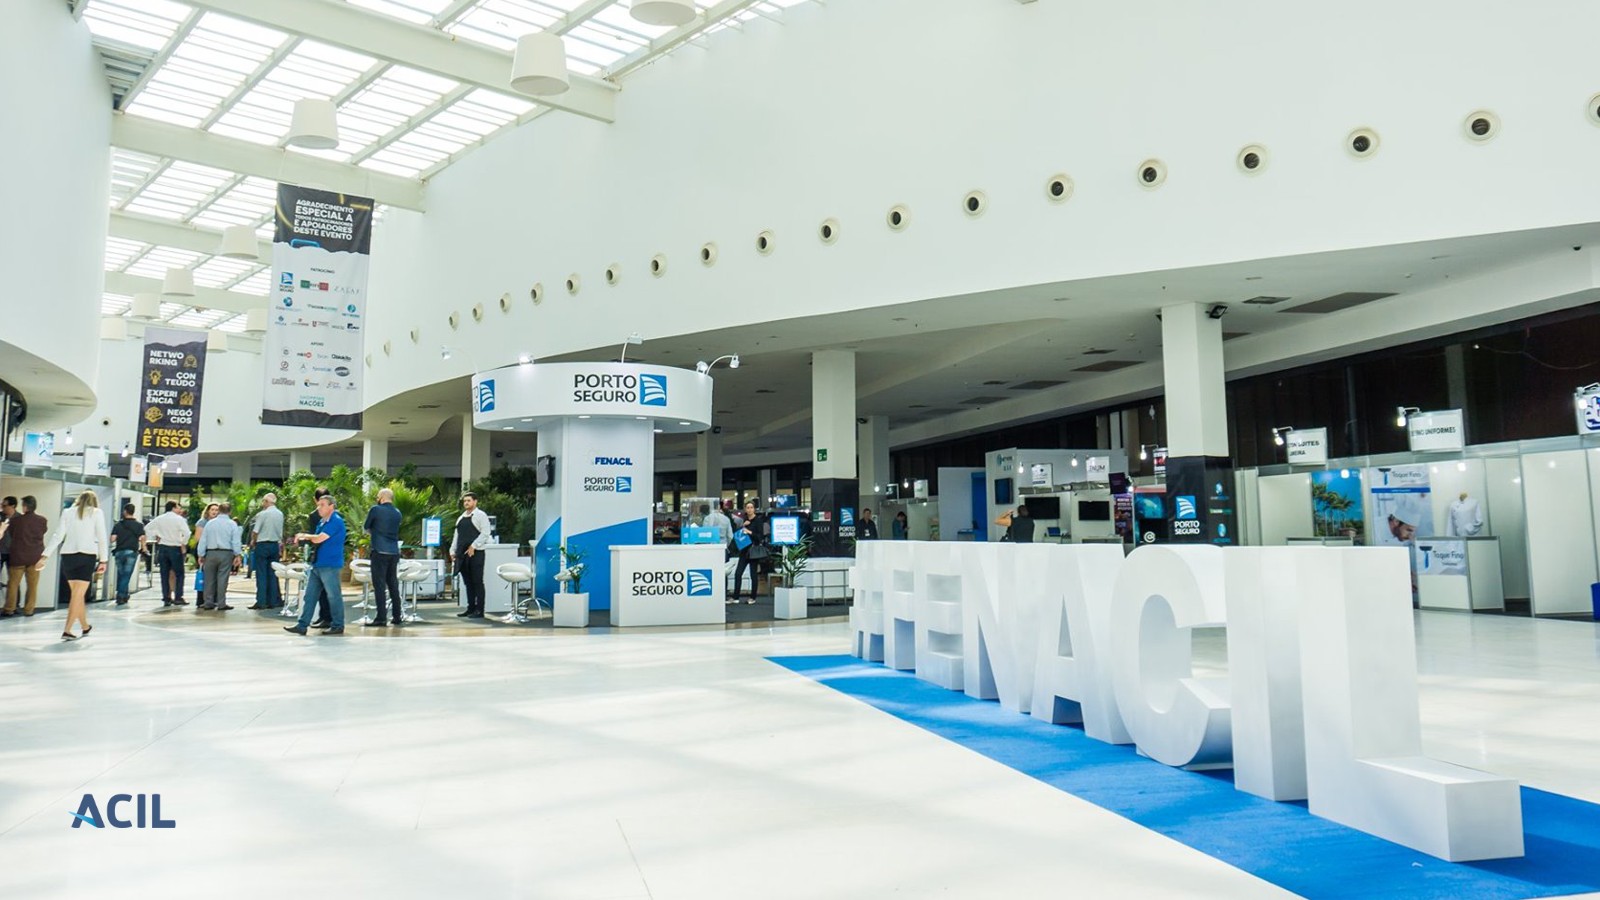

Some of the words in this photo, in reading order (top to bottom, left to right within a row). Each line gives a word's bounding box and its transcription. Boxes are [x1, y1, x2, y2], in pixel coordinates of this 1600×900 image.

[296, 199, 354, 214] AGRADECIMENTO
[295, 205, 343, 220] ESPECIAL
[345, 213, 353, 222] A
[301, 220, 353, 234] APOIADORES
[294, 226, 320, 236] DESTE
[320, 230, 353, 241] EVENTO
[150, 349, 184, 360] NETWO
[149, 357, 178, 366] RKING
[574, 374, 637, 389] PORTO
[146, 389, 178, 398] EXPERI
[573, 390, 637, 403] SEGURO
[167, 408, 193, 417] NEGÓ
[170, 416, 193, 424] CIOS
[143, 427, 151, 435] A
[153, 428, 192, 438] FENACIL
[155, 435, 192, 448] ISSO
[594, 456, 633, 466] FENACIL
[584, 477, 615, 485] PORTO
[1174, 520, 1200, 529] PORTO
[1174, 527, 1200, 536] SEGURO
[1433, 550, 1450, 560] Toque
[1450, 550, 1464, 560] Fino
[632, 571, 684, 584] PORTO
[632, 584, 684, 596] SEGURO
